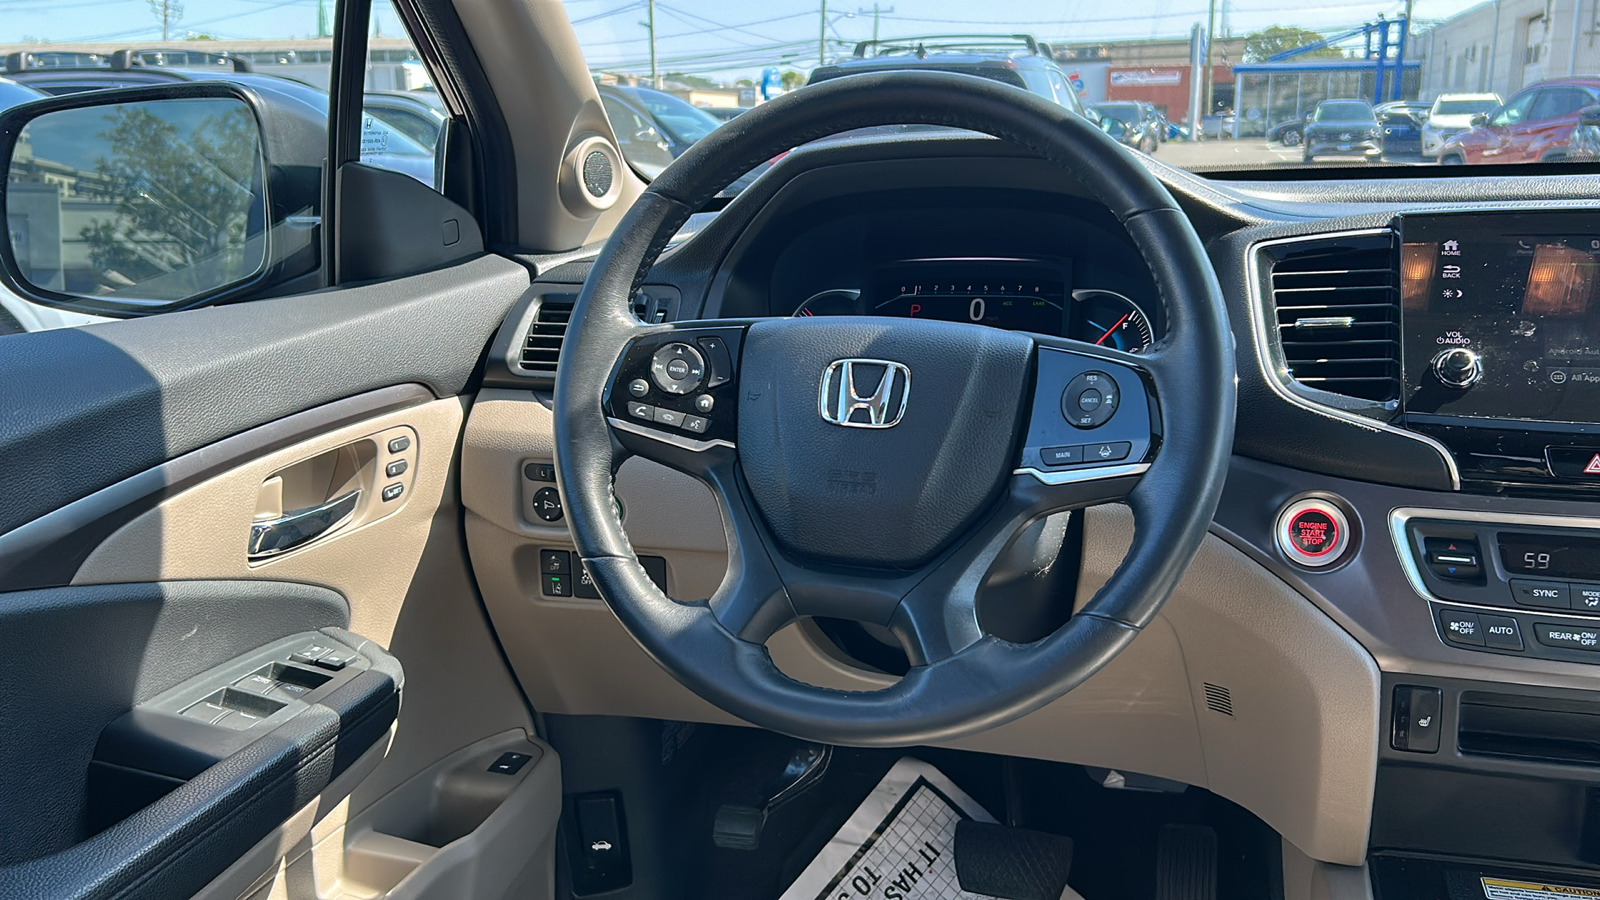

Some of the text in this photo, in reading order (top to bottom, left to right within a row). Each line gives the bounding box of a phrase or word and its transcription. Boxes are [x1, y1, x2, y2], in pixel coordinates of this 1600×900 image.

[910, 304, 921, 317] P
[969, 298, 985, 321] 0
[1122, 322, 1128, 330] F
[1299, 521, 1327, 530] ENGINE
[1524, 552, 1550, 569] 59
[1533, 589, 1559, 598] SYNC
[1459, 627, 1475, 635] OFF
[1489, 626, 1513, 635] AUTO
[1549, 631, 1572, 640] REAR
[1580, 638, 1597, 646] OFF
[918, 841, 941, 868] IT
[851, 866, 882, 896] TO
[884, 861, 924, 900] HAS
[1554, 886, 1600, 897] CAUTION
